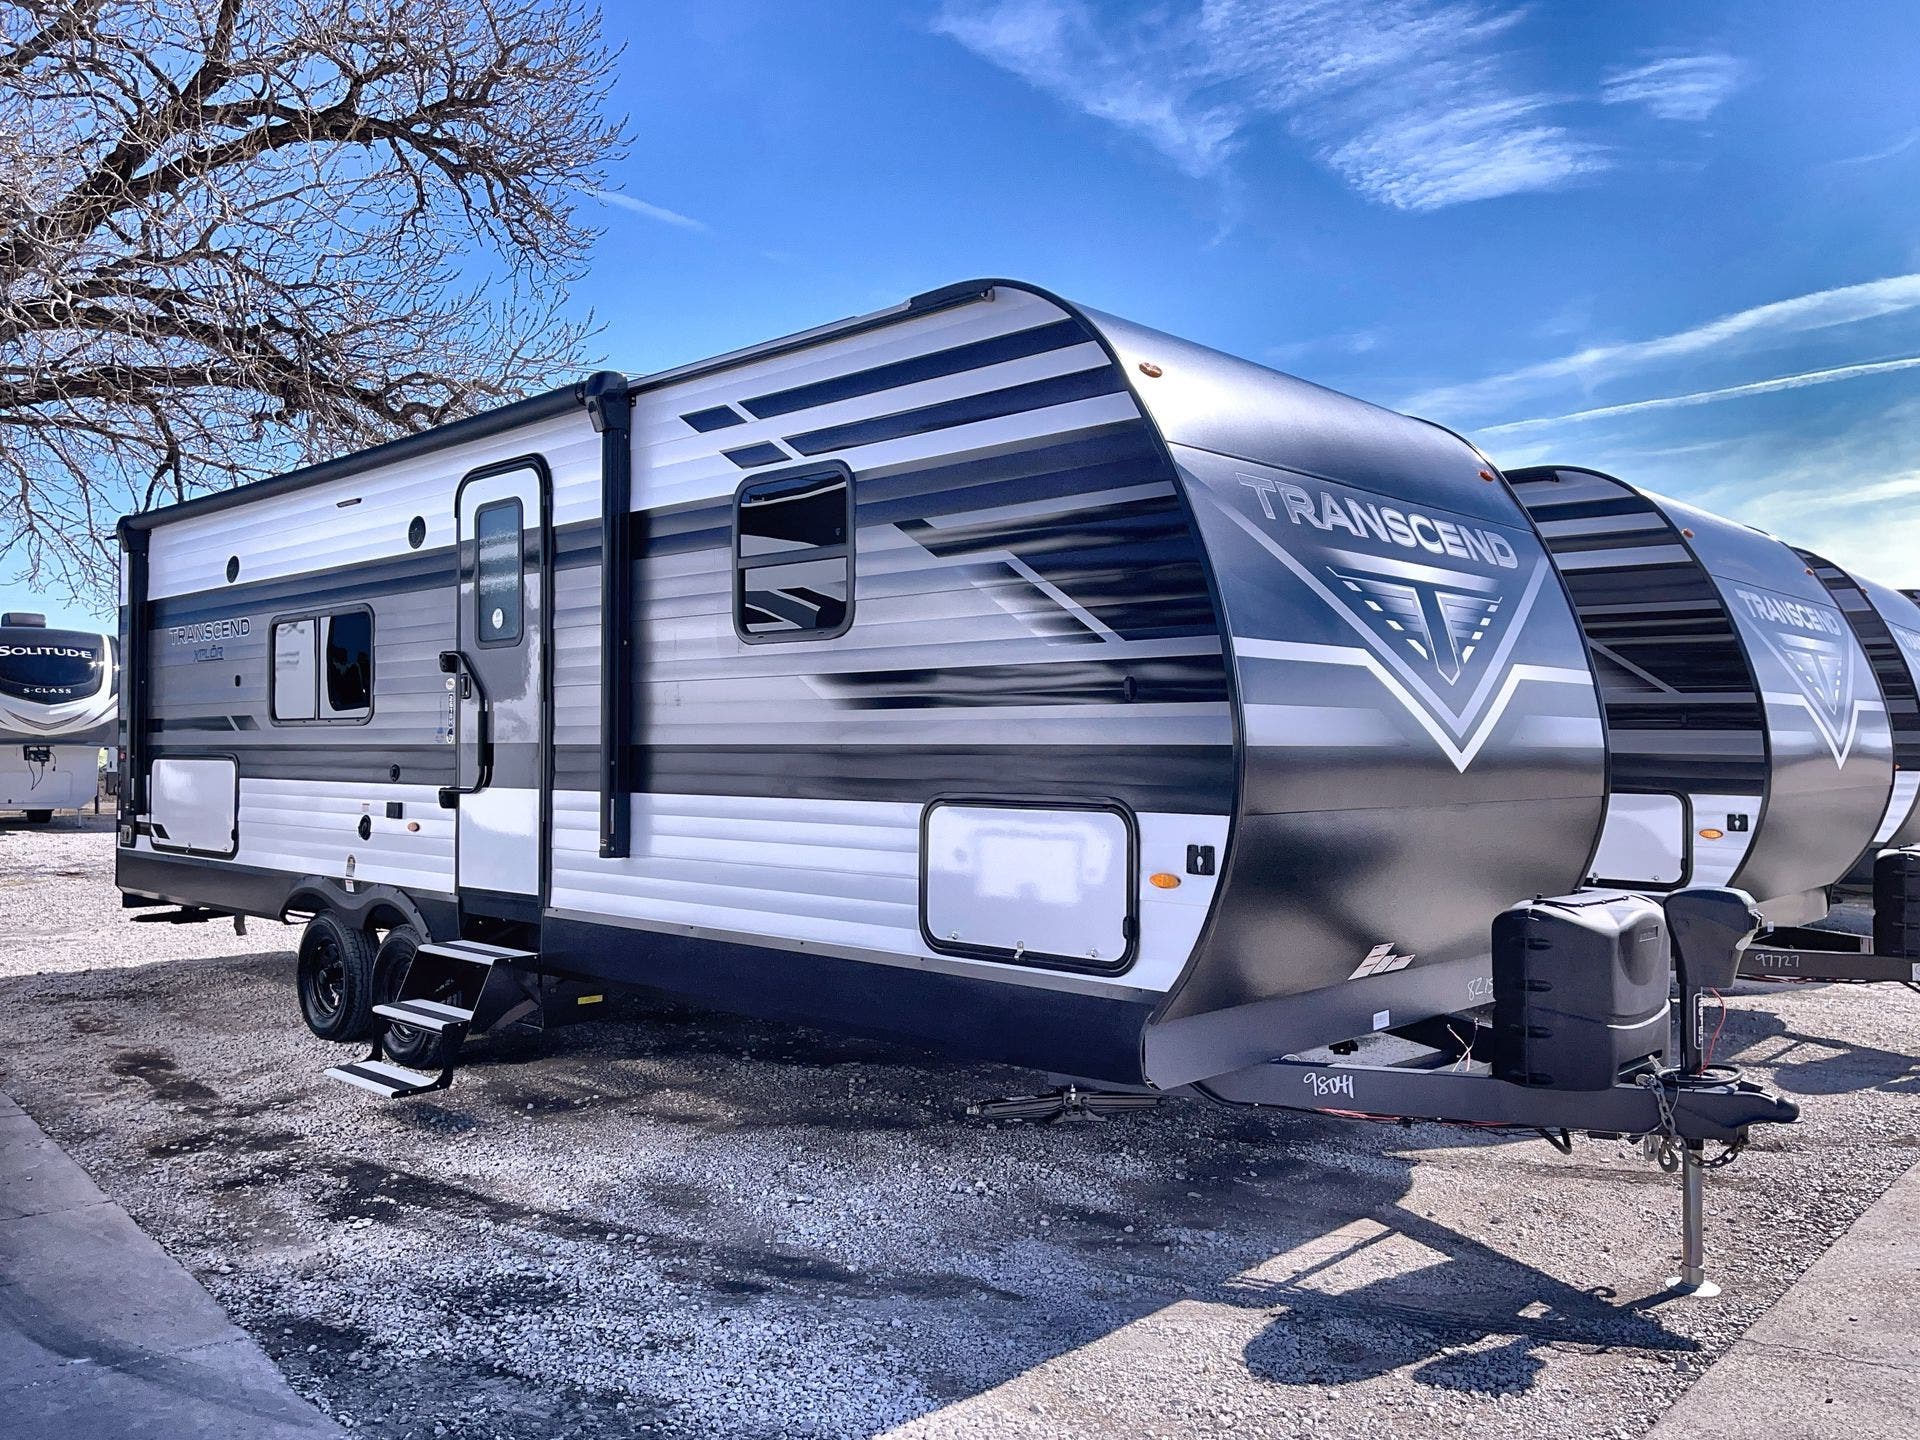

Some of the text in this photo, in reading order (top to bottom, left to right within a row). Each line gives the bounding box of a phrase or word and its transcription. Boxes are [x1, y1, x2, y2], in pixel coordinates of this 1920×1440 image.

[1235, 472, 1518, 569] TRANSCEND
[1735, 589, 1841, 636] TRANSCEND
[169, 617, 251, 645] TRANSCEND
[0, 646, 92, 659] SOLITUDE
[1755, 953, 1800, 968] 97727
